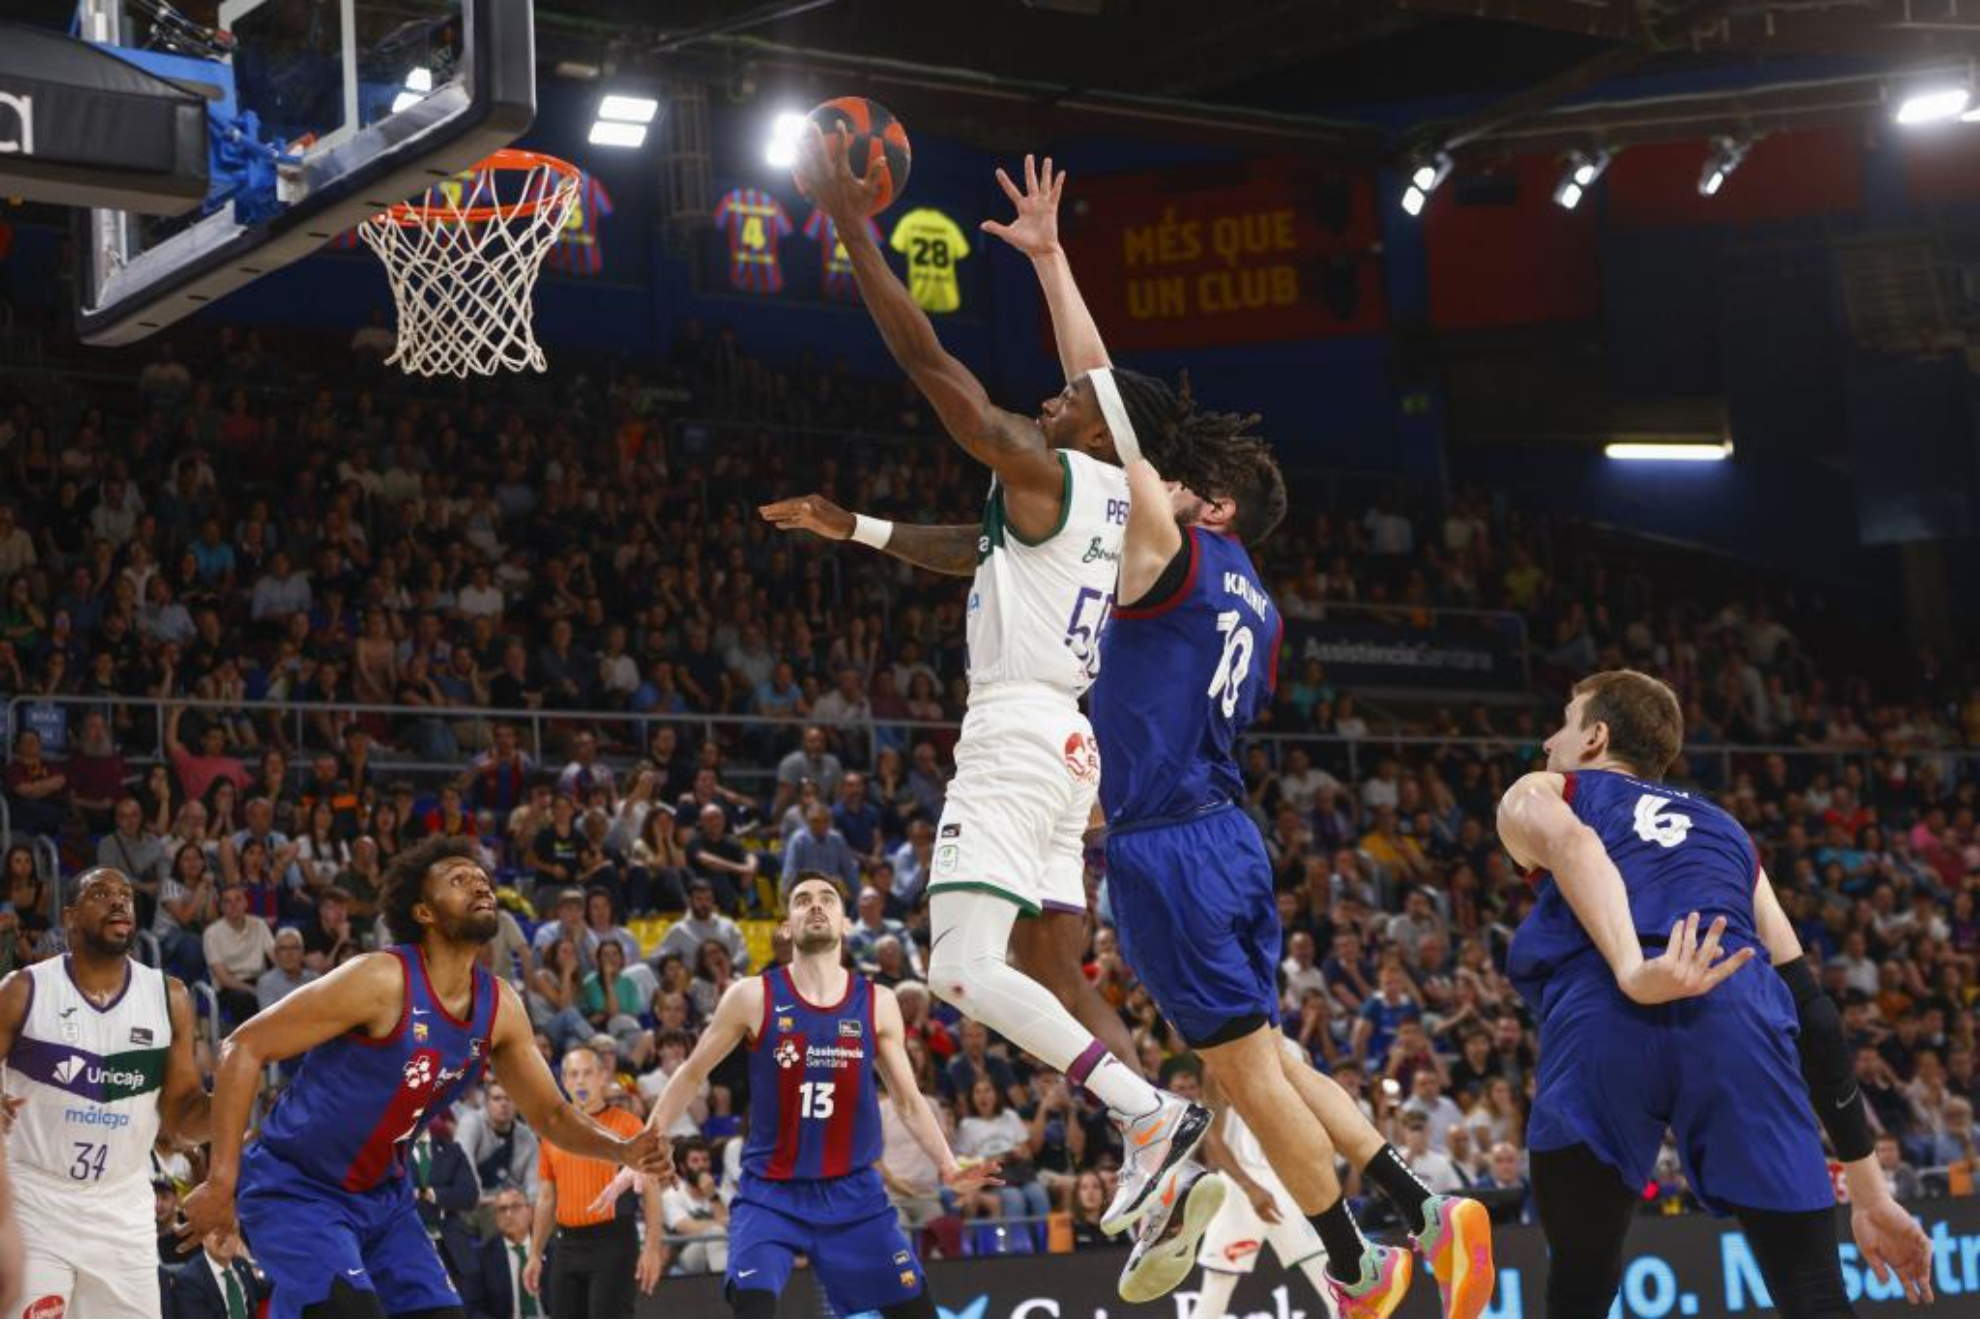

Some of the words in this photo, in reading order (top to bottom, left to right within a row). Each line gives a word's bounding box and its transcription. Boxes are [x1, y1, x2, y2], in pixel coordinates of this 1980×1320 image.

[911, 237, 949, 269] 28
[1124, 208, 1201, 265] MÉS
[1213, 208, 1296, 267] QUE
[1128, 276, 1186, 319] UN
[1198, 266, 1298, 311] CLUB
[1207, 609, 1254, 718] 10
[1633, 794, 1690, 848] 6
[87, 1067, 145, 1090] Unicaja
[65, 1105, 130, 1129] málaga
[799, 1081, 835, 1119] 13
[70, 1142, 108, 1181] 34
